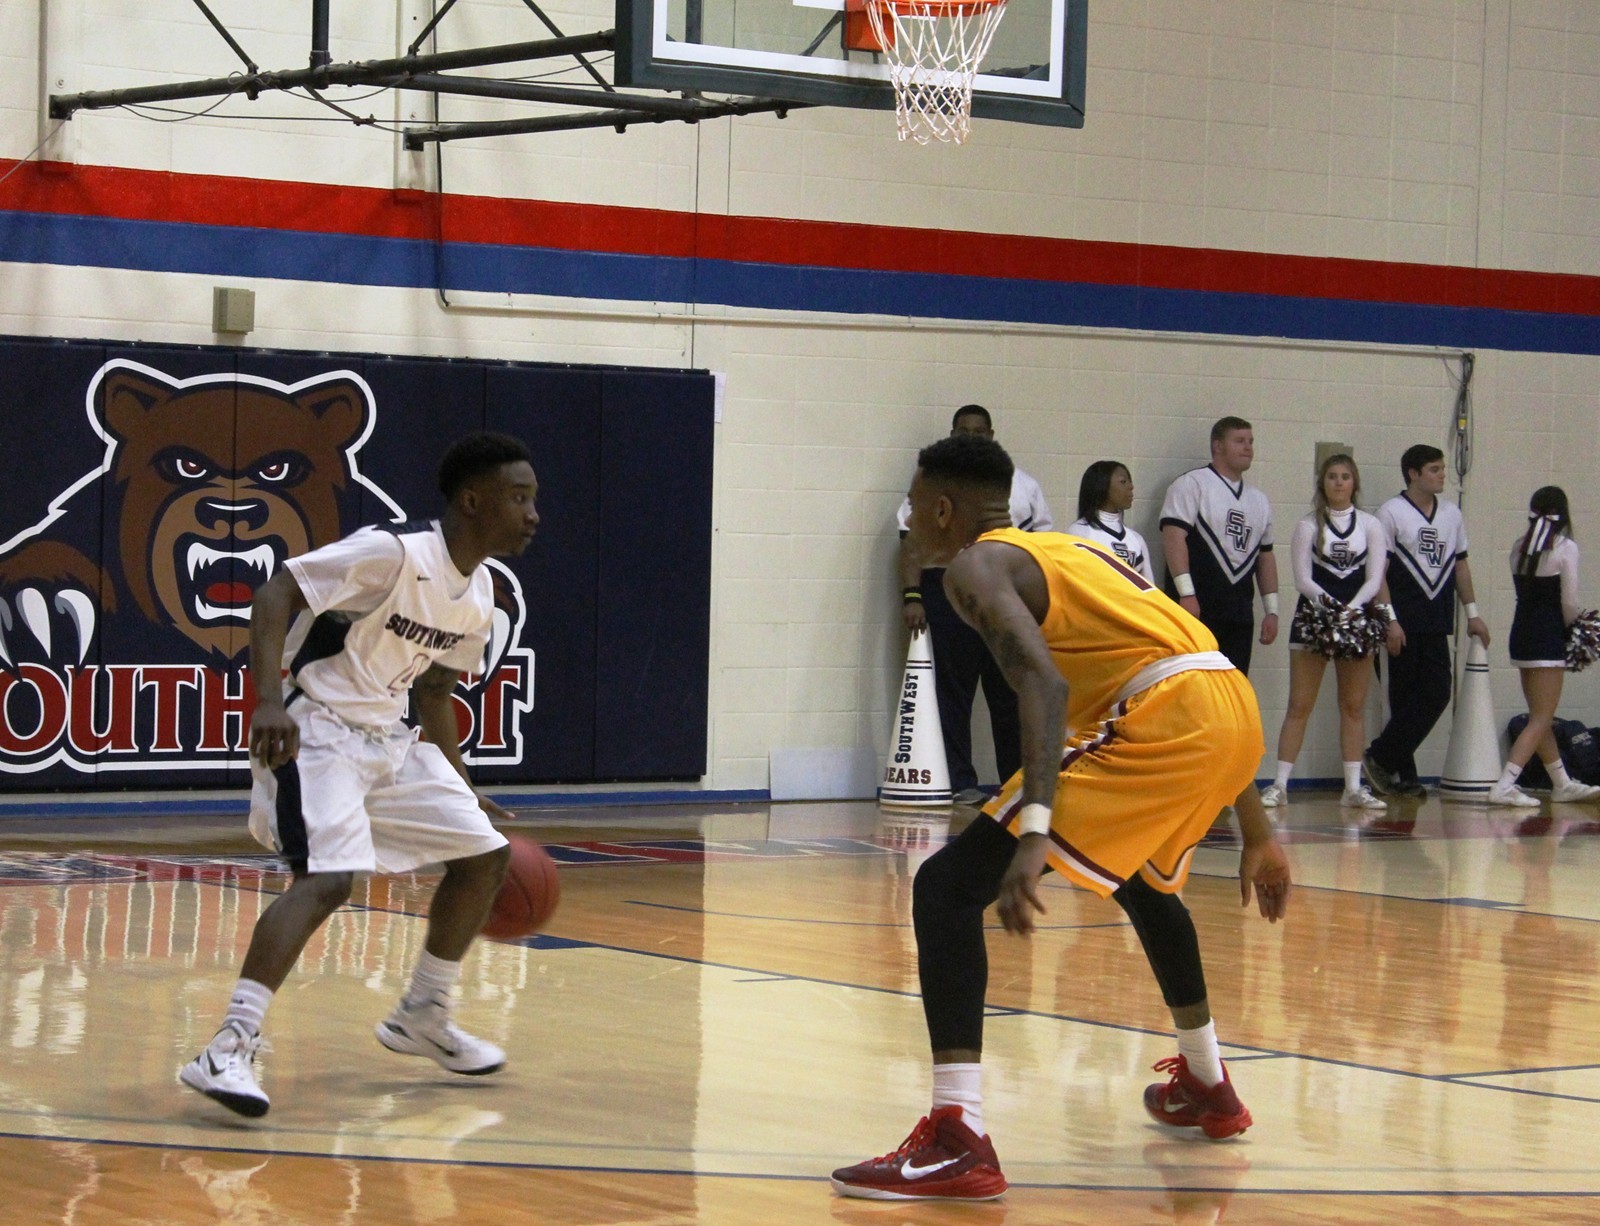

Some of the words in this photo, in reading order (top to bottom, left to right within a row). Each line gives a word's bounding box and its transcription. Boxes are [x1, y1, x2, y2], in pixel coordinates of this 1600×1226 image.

[1225, 508, 1252, 553] SW
[1418, 527, 1446, 568] SW
[1072, 542, 1156, 592] 1
[1330, 541, 1357, 570] SW
[384, 613, 466, 651] SOUTHWE
[0, 662, 522, 757] OUTHT
[894, 673, 919, 764] SOUTHWEST
[884, 766, 931, 785] EARS
